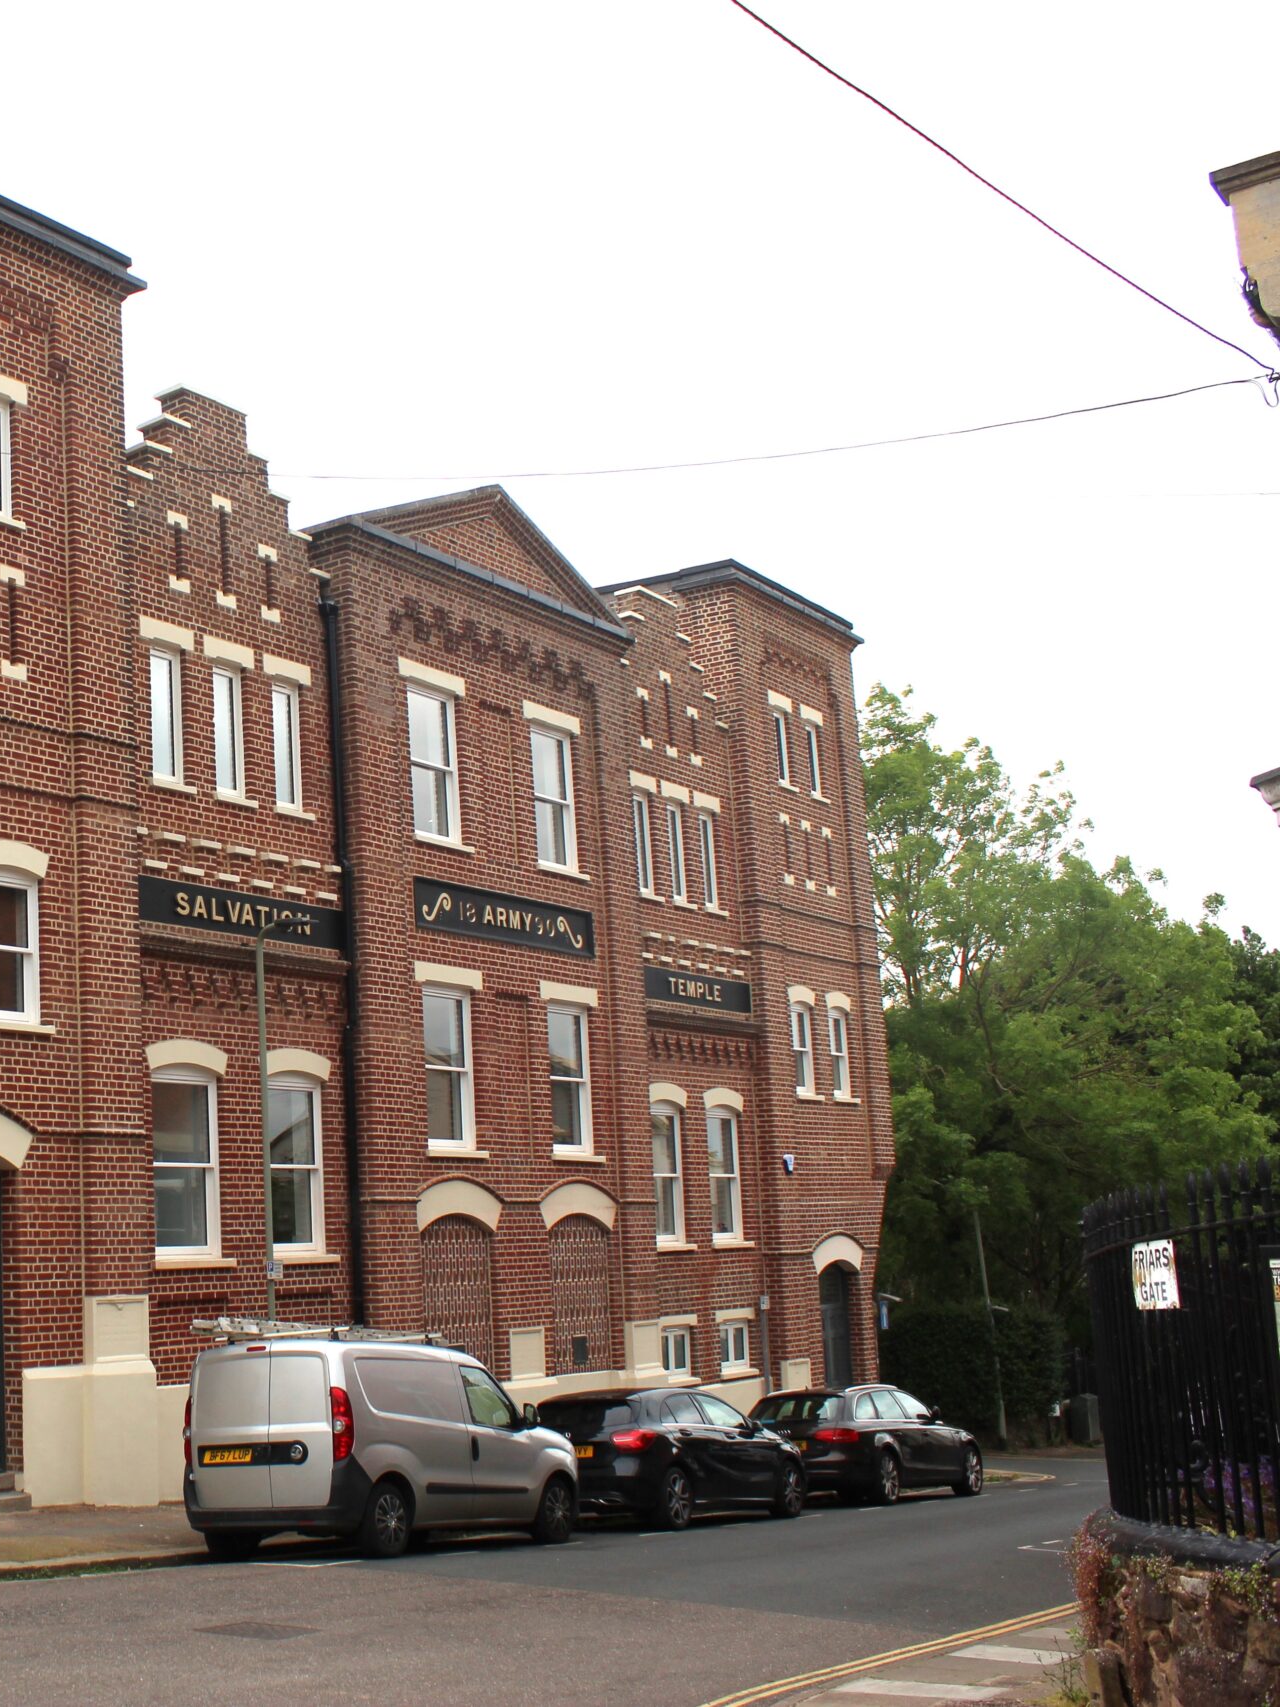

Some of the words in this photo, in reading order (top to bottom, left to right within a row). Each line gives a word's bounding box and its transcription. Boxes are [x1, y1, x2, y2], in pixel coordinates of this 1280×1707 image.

[483, 905, 532, 932] ARMY
[668, 977, 722, 1002] TEMPLE
[1133, 1247, 1170, 1271] FRIARS
[1140, 1282, 1168, 1302] GATE
